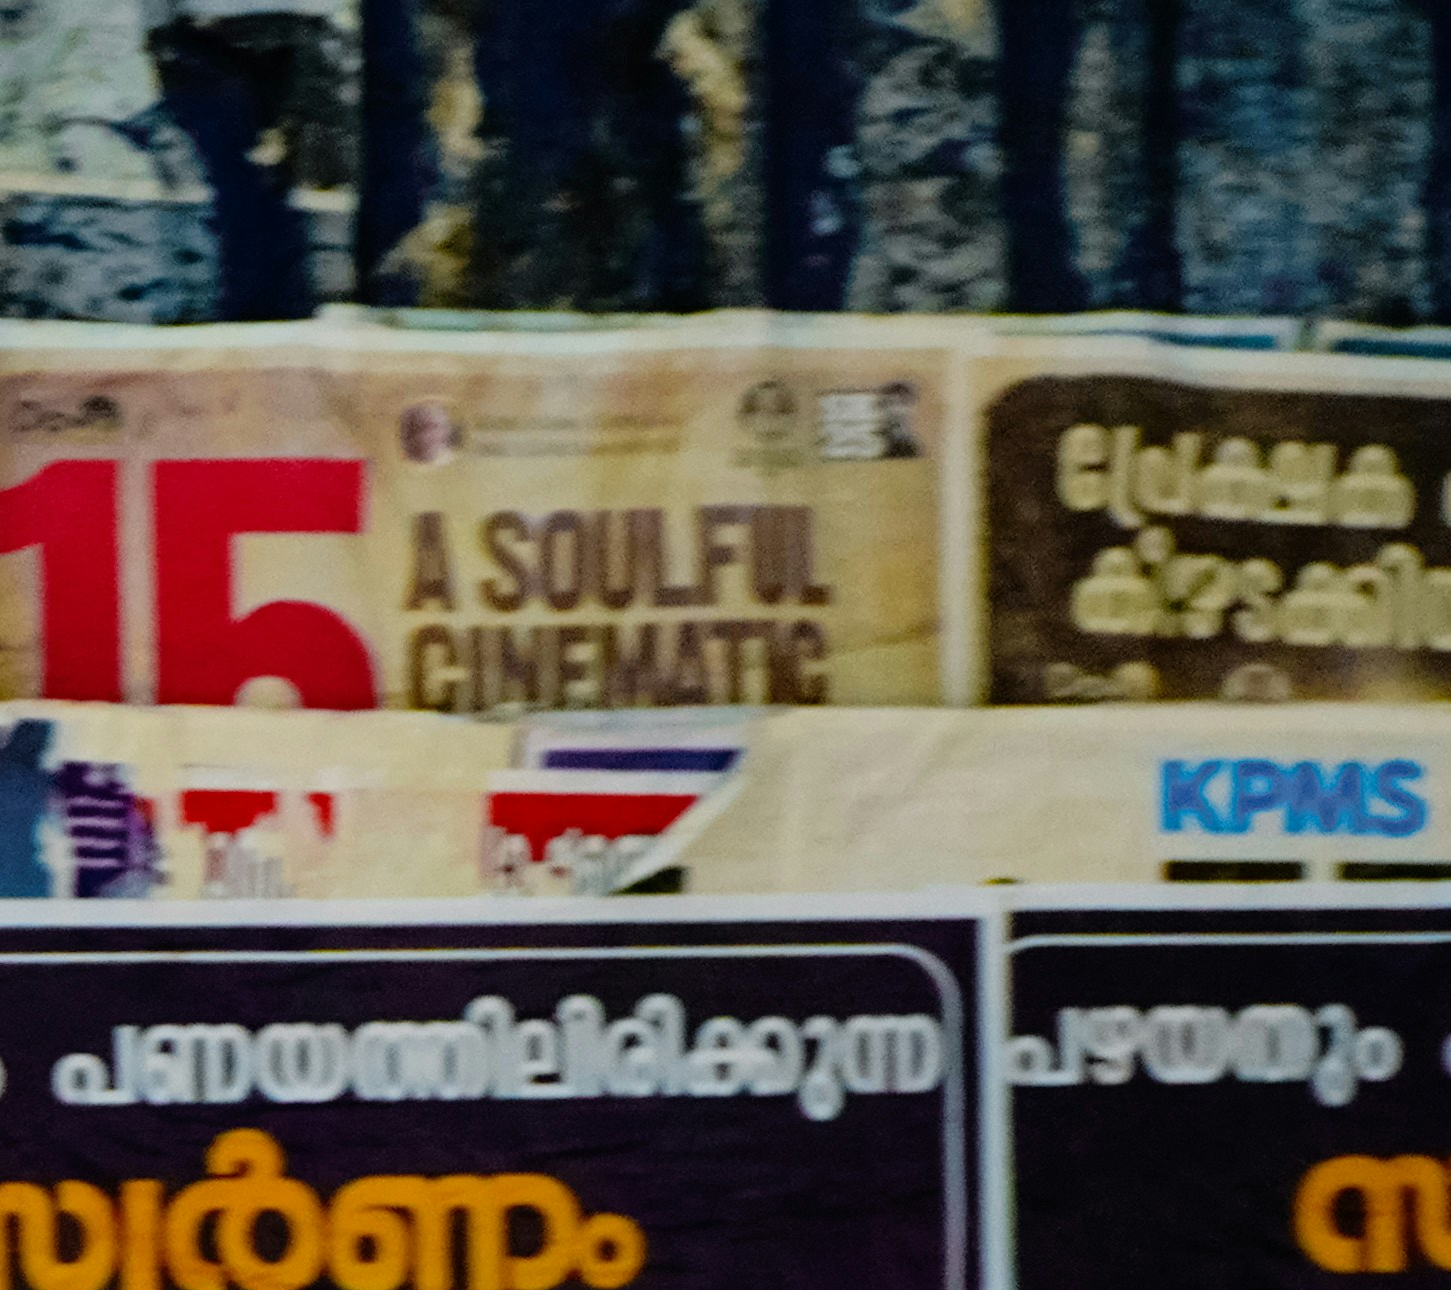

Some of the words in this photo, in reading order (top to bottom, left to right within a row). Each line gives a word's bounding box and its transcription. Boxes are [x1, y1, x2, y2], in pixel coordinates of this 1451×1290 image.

[405, 510, 455, 613] A
[480, 503, 835, 612] SOULFUL
[406, 619, 832, 713] CINEMATIC
[1157, 756, 1430, 839] KPMS
[51, 994, 945, 1121] പണയത്തിലിരിക്കുന്ന
[1007, 1004, 1405, 1108] പഴയതും
